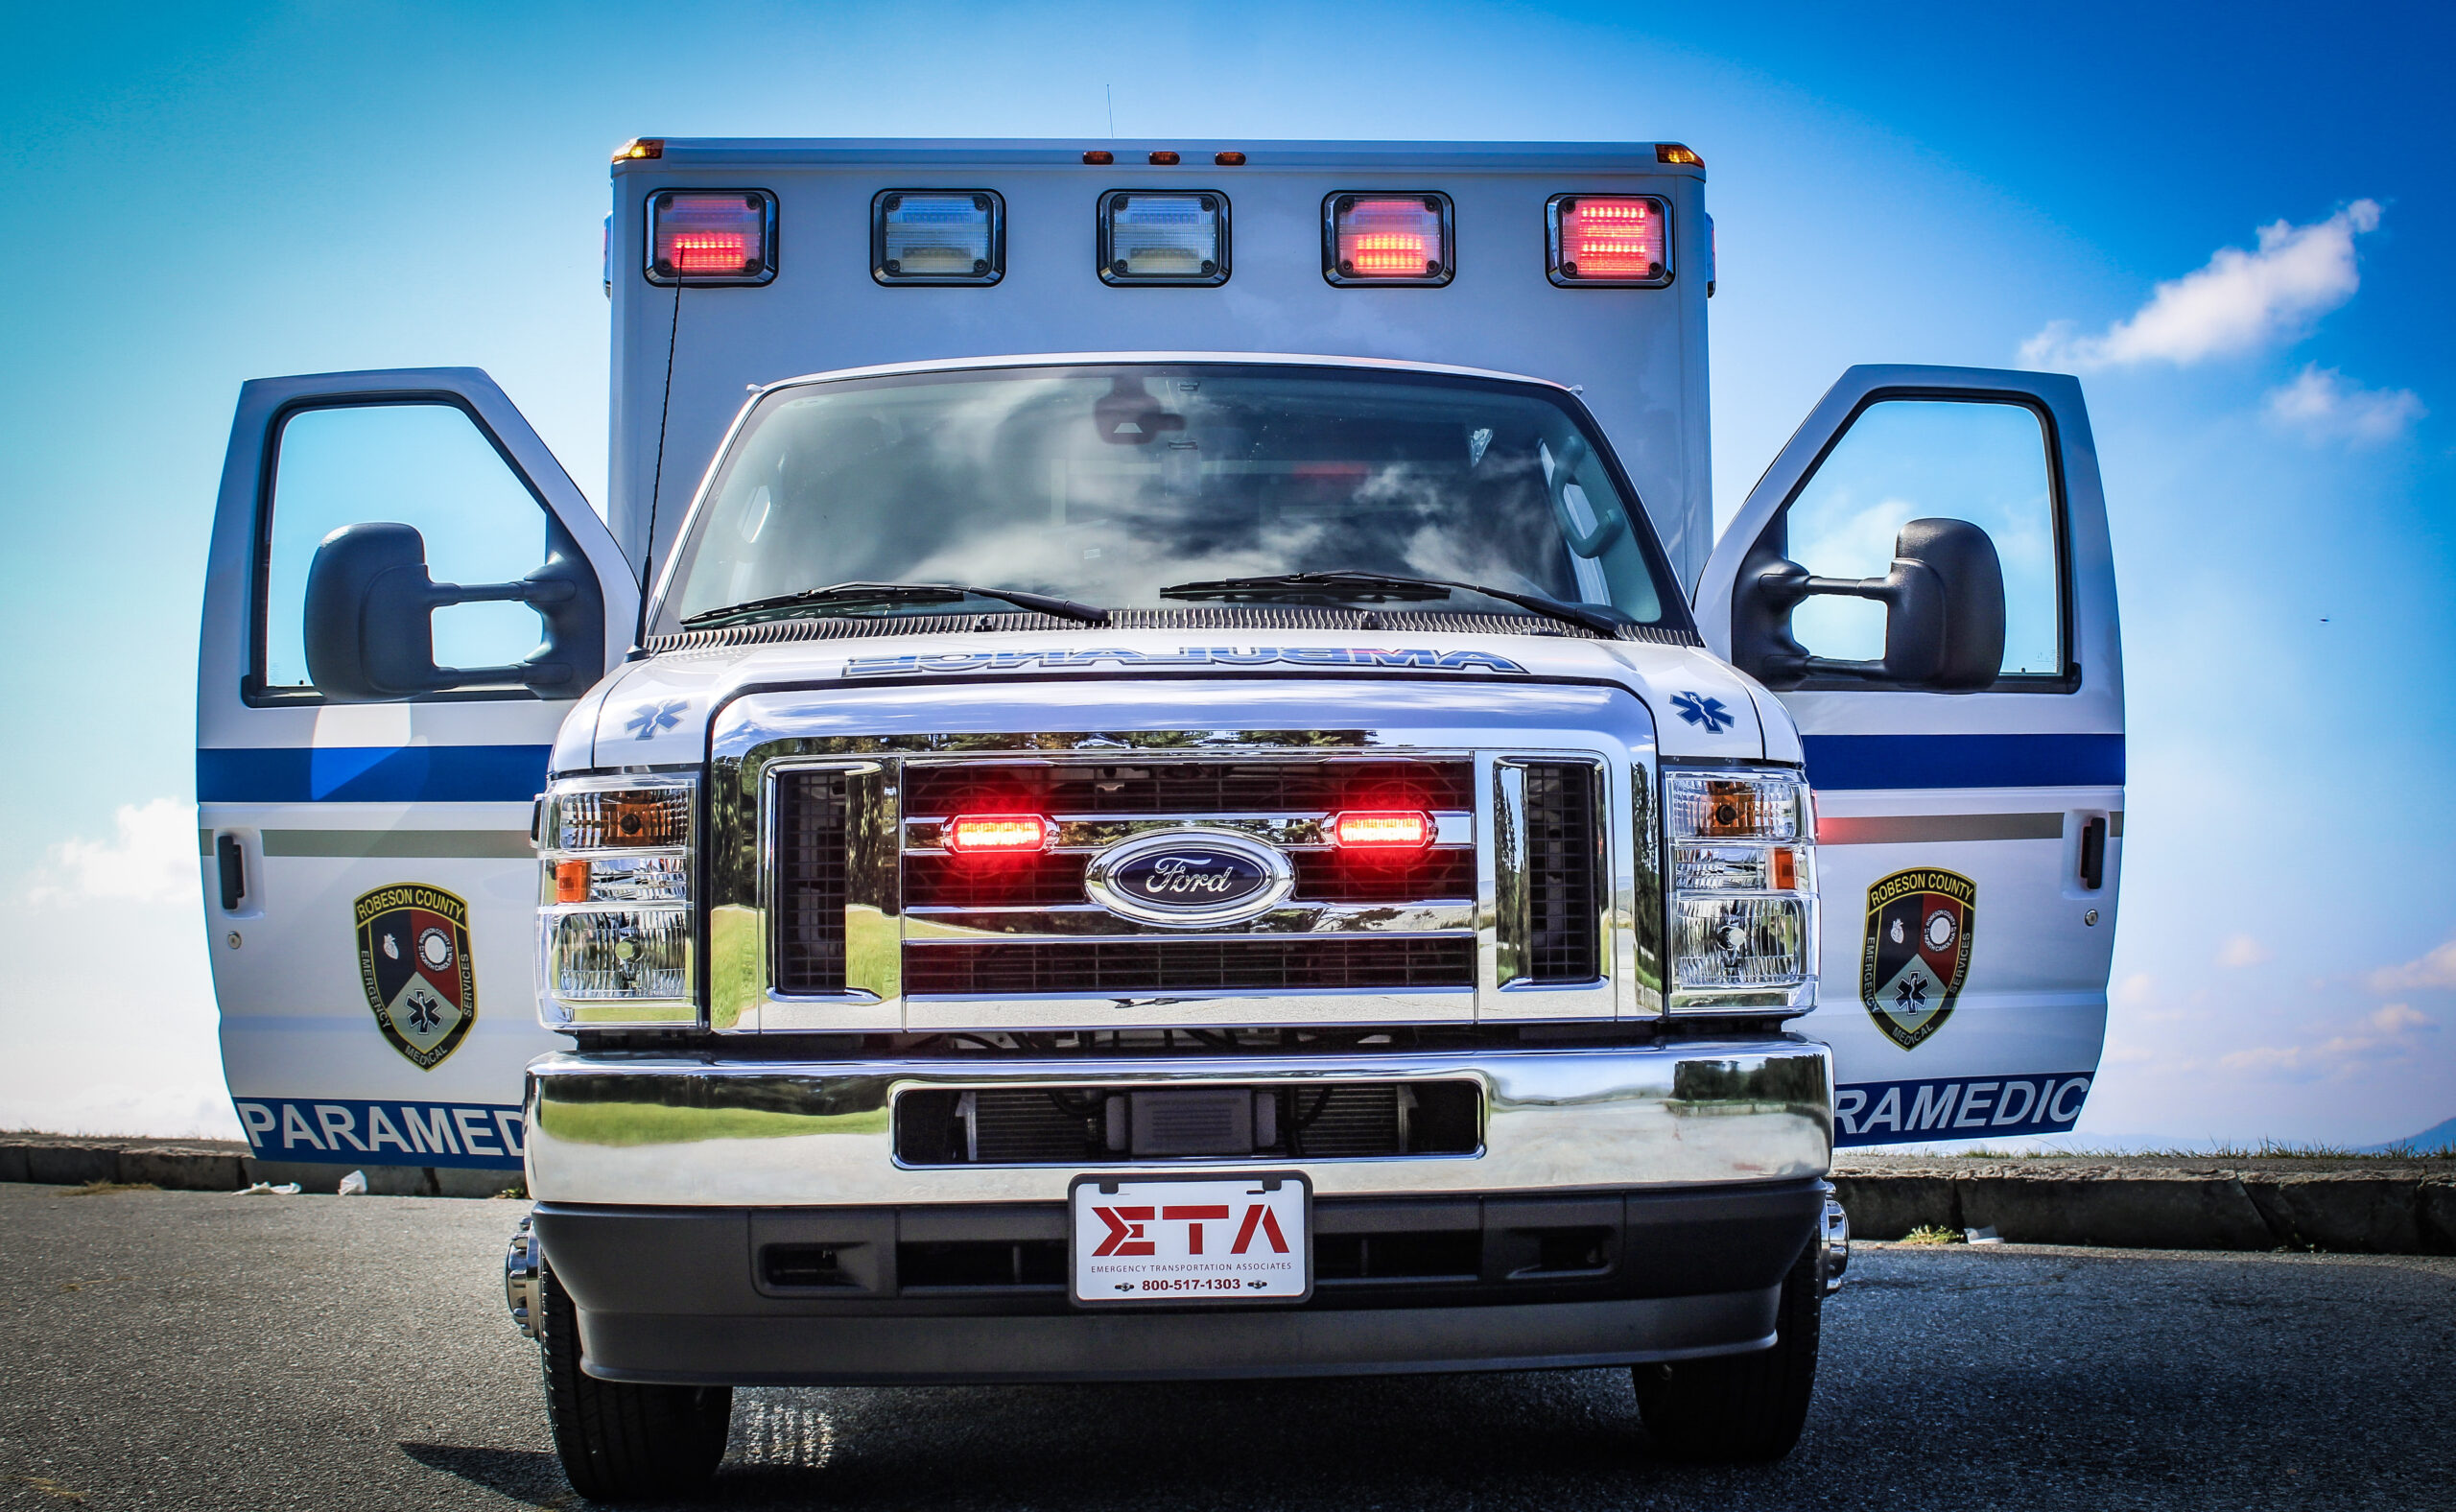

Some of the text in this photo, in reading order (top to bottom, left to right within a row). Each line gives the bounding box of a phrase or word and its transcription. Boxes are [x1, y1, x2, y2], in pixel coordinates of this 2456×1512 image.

[1145, 857, 1234, 893] Ford
[1871, 873, 1974, 907] ROBESON COUNTY
[356, 888, 464, 920] ROBESON COUNTY
[1864, 936, 1879, 1013] EMERGENCY
[1949, 932, 1971, 994] SERVICES
[361, 950, 391, 1028] EMERGENCY
[460, 954, 470, 1018] SERVICES
[1892, 1024, 1934, 1046] MEDICAL
[404, 1045, 448, 1066] MEDICAL
[1091, 1262, 1292, 1273] EMERGENCY TRANSPORTATION ASSOCIATES
[1142, 1278, 1241, 1291] 800-517-1303
